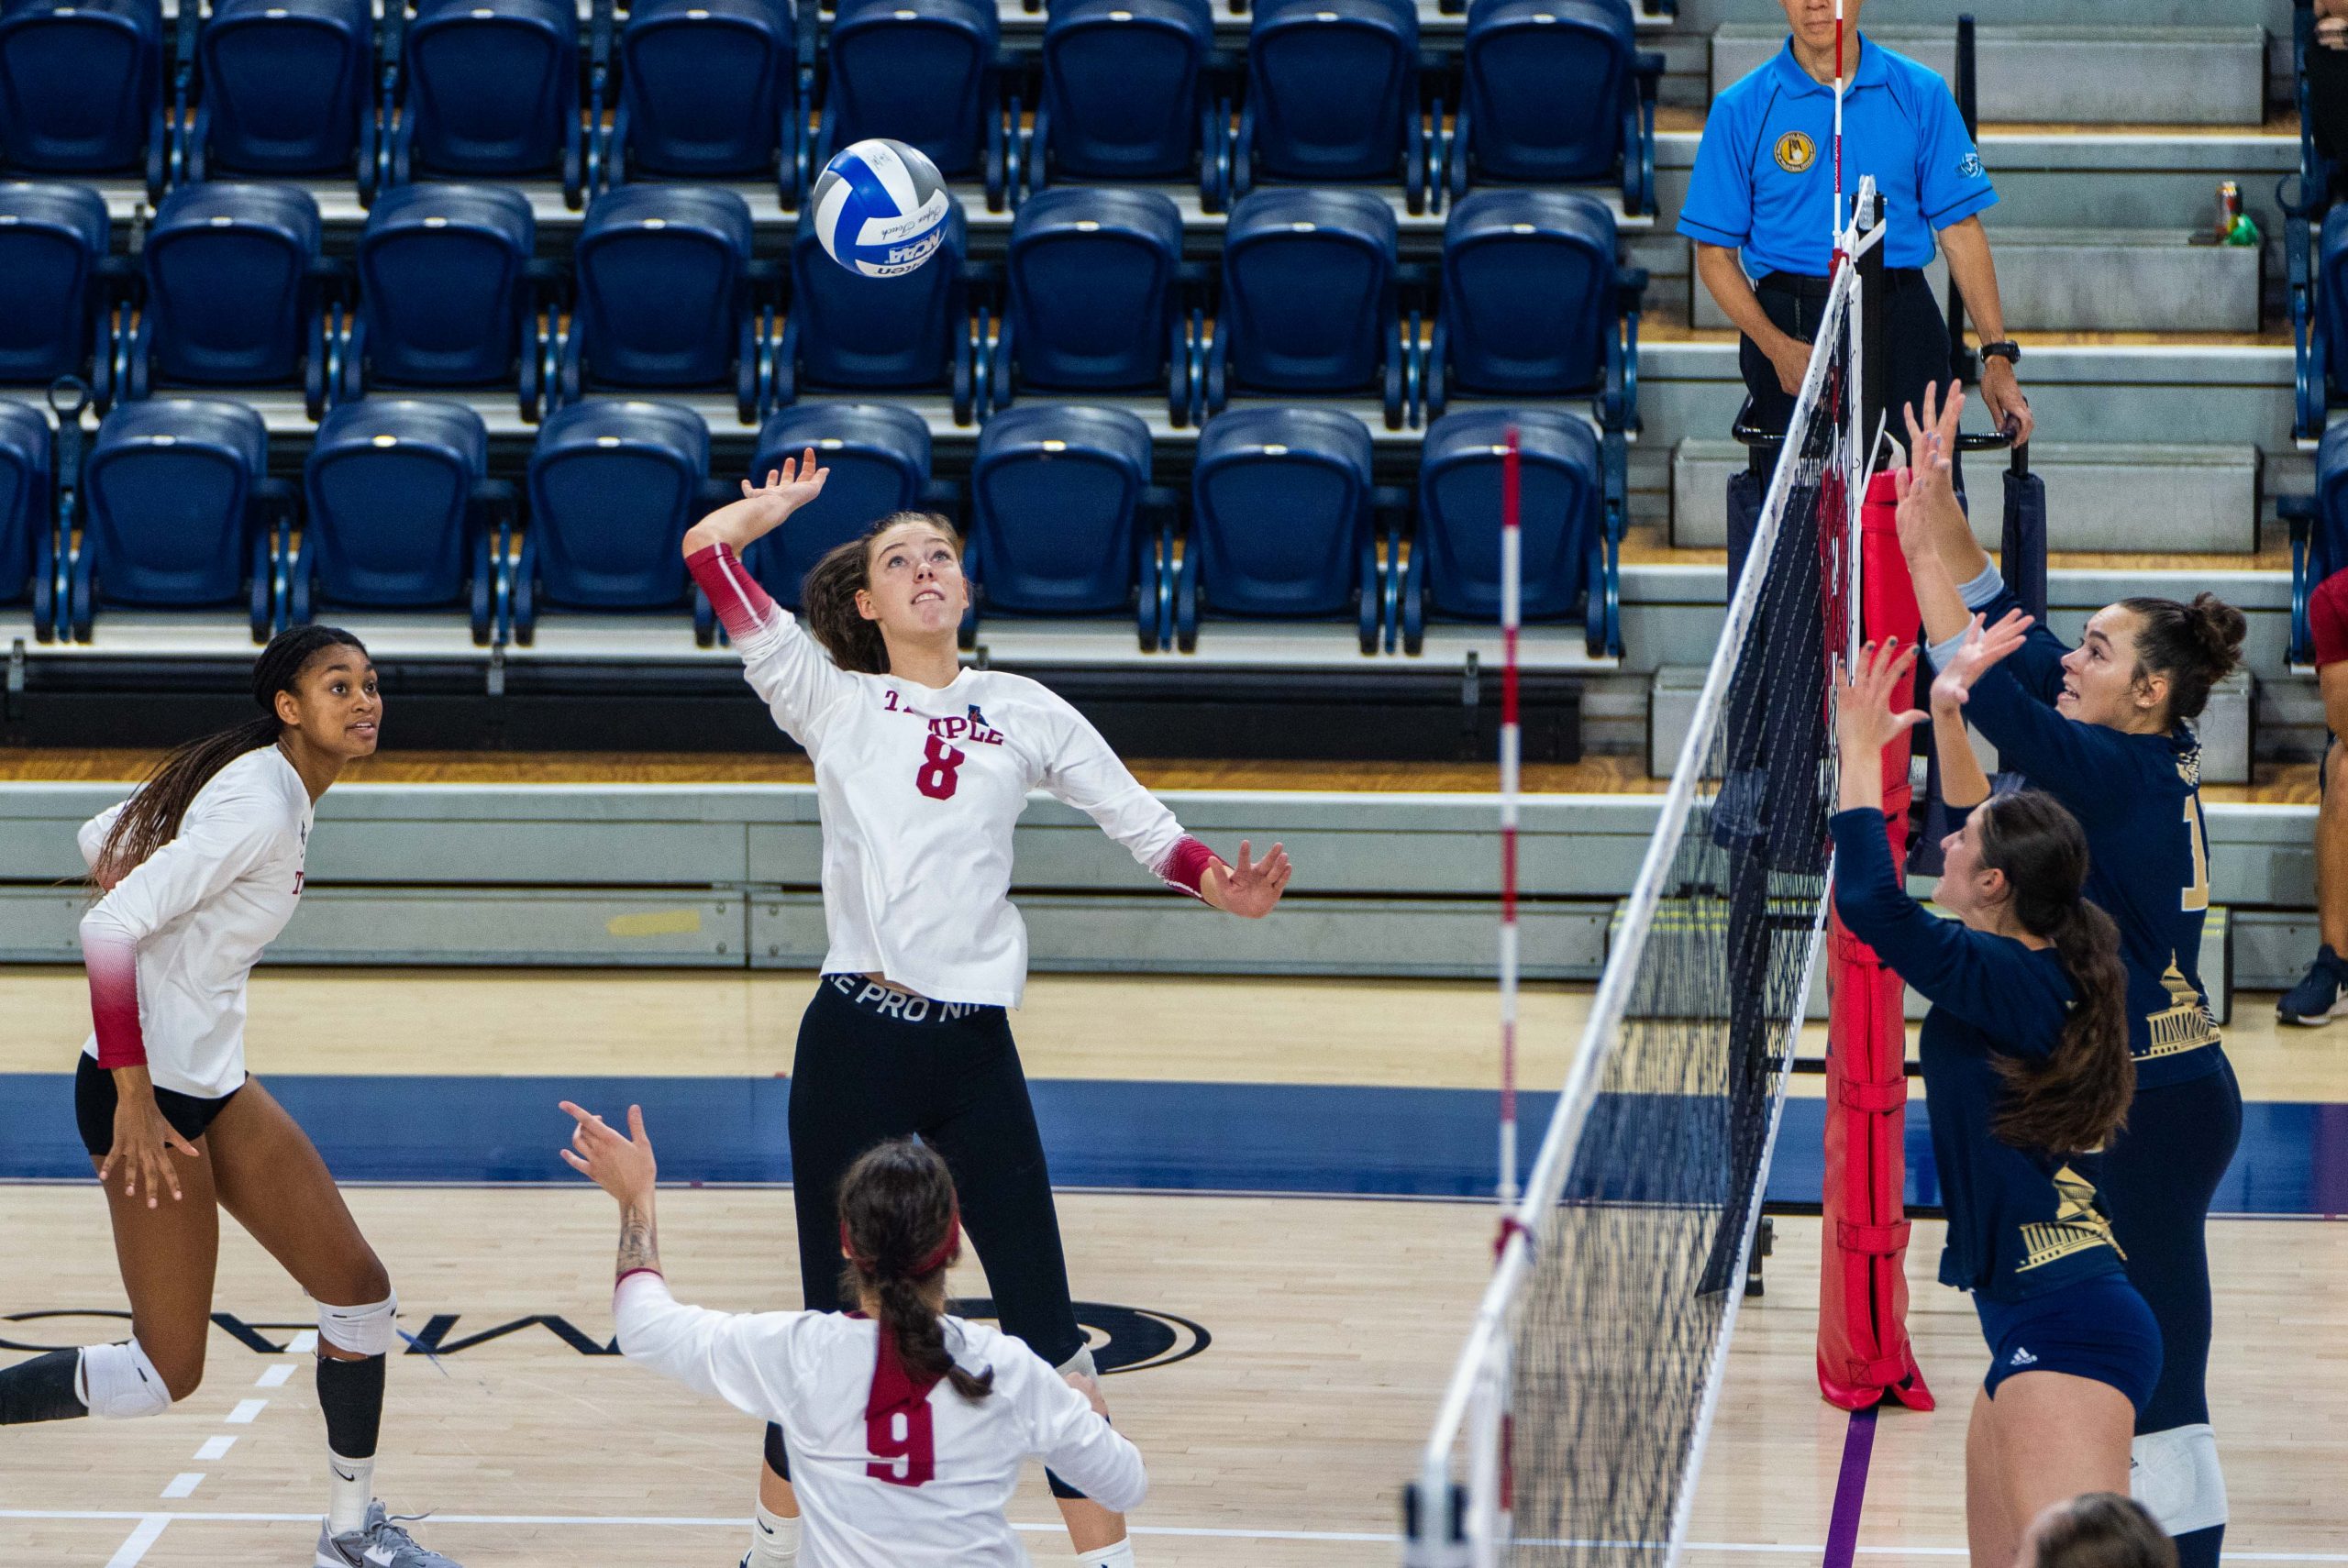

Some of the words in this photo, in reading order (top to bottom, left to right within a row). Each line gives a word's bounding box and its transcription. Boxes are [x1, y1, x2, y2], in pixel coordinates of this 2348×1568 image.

[915, 734, 966, 801] 8
[855, 982, 930, 1022] PRO
[865, 1397, 935, 1487] 9
